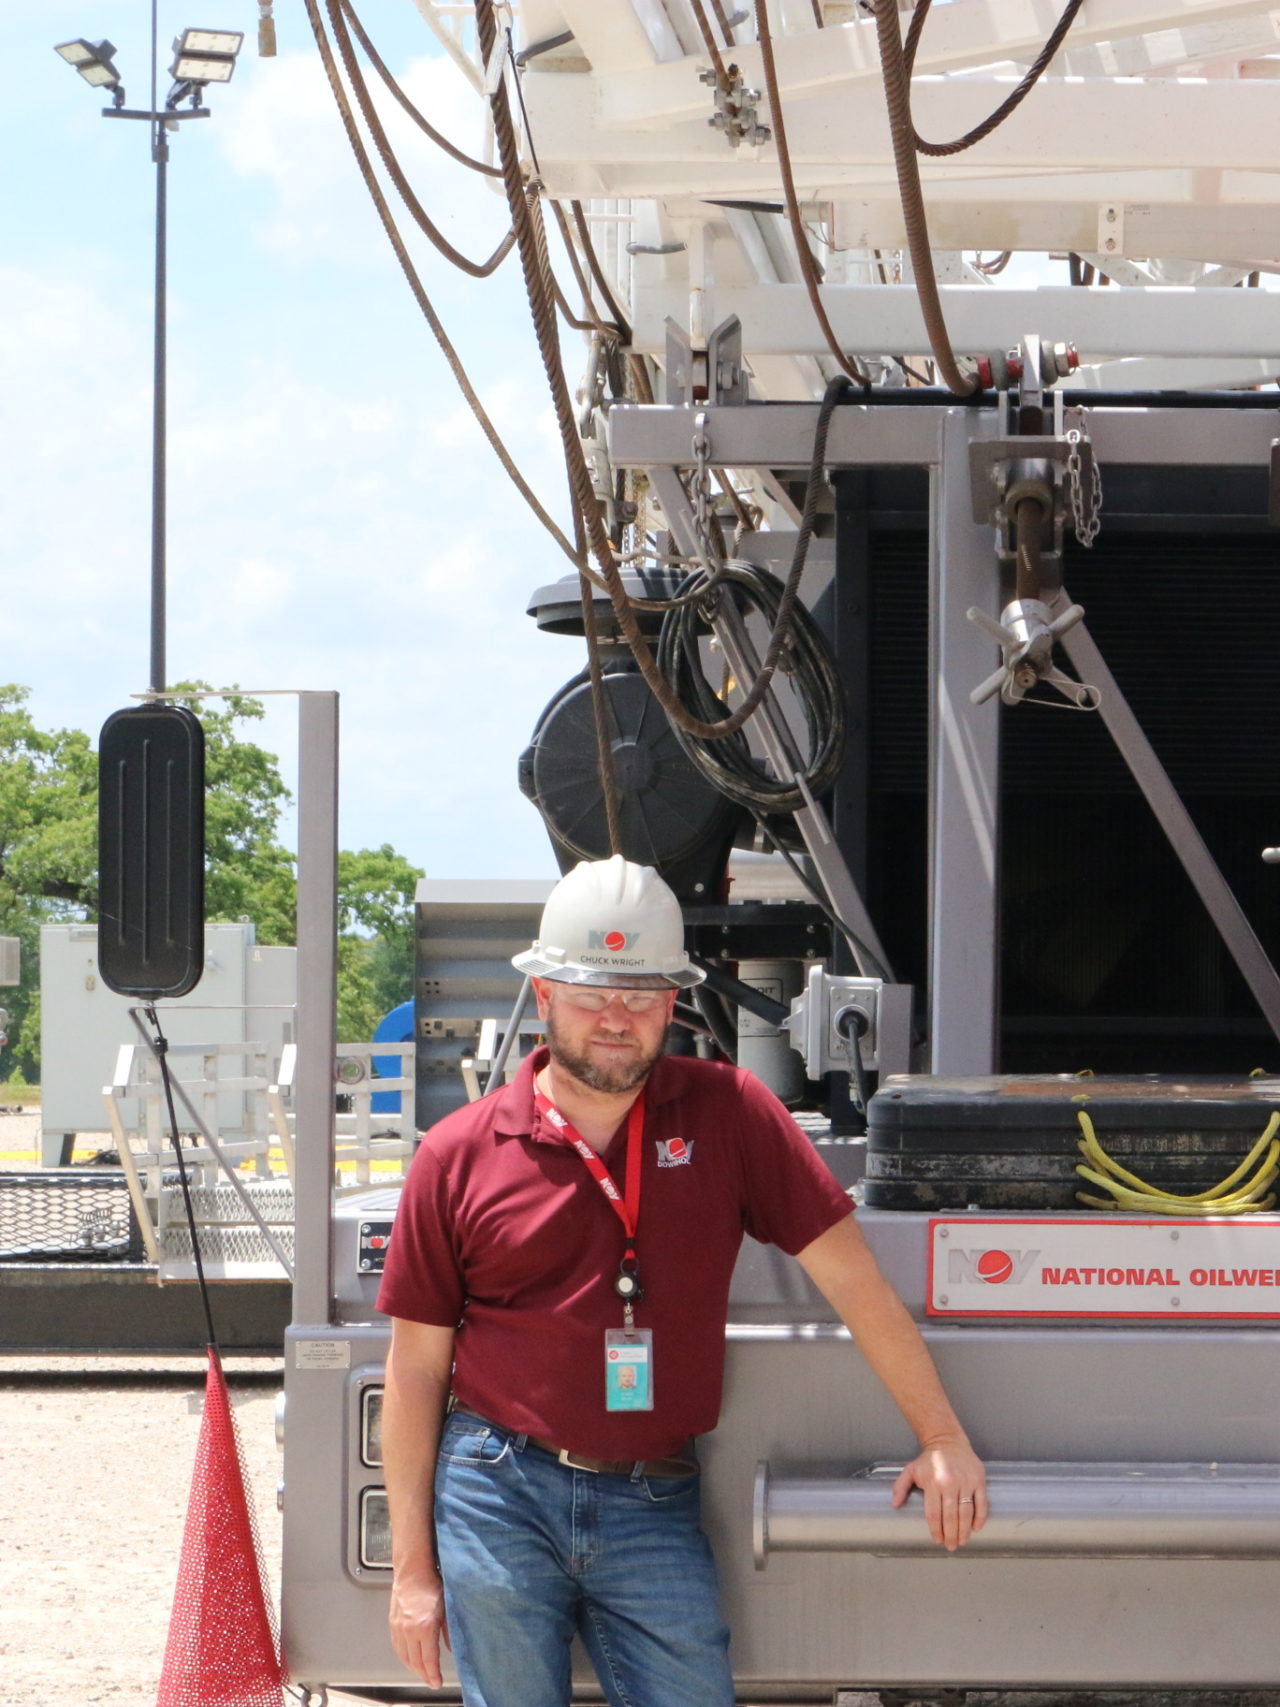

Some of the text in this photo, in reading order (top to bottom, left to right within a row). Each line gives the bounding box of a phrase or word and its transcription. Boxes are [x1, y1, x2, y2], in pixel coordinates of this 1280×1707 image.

[580, 955, 646, 967] CHUCK WRIGHT
[1041, 1267, 1181, 1286] NATIONAL
